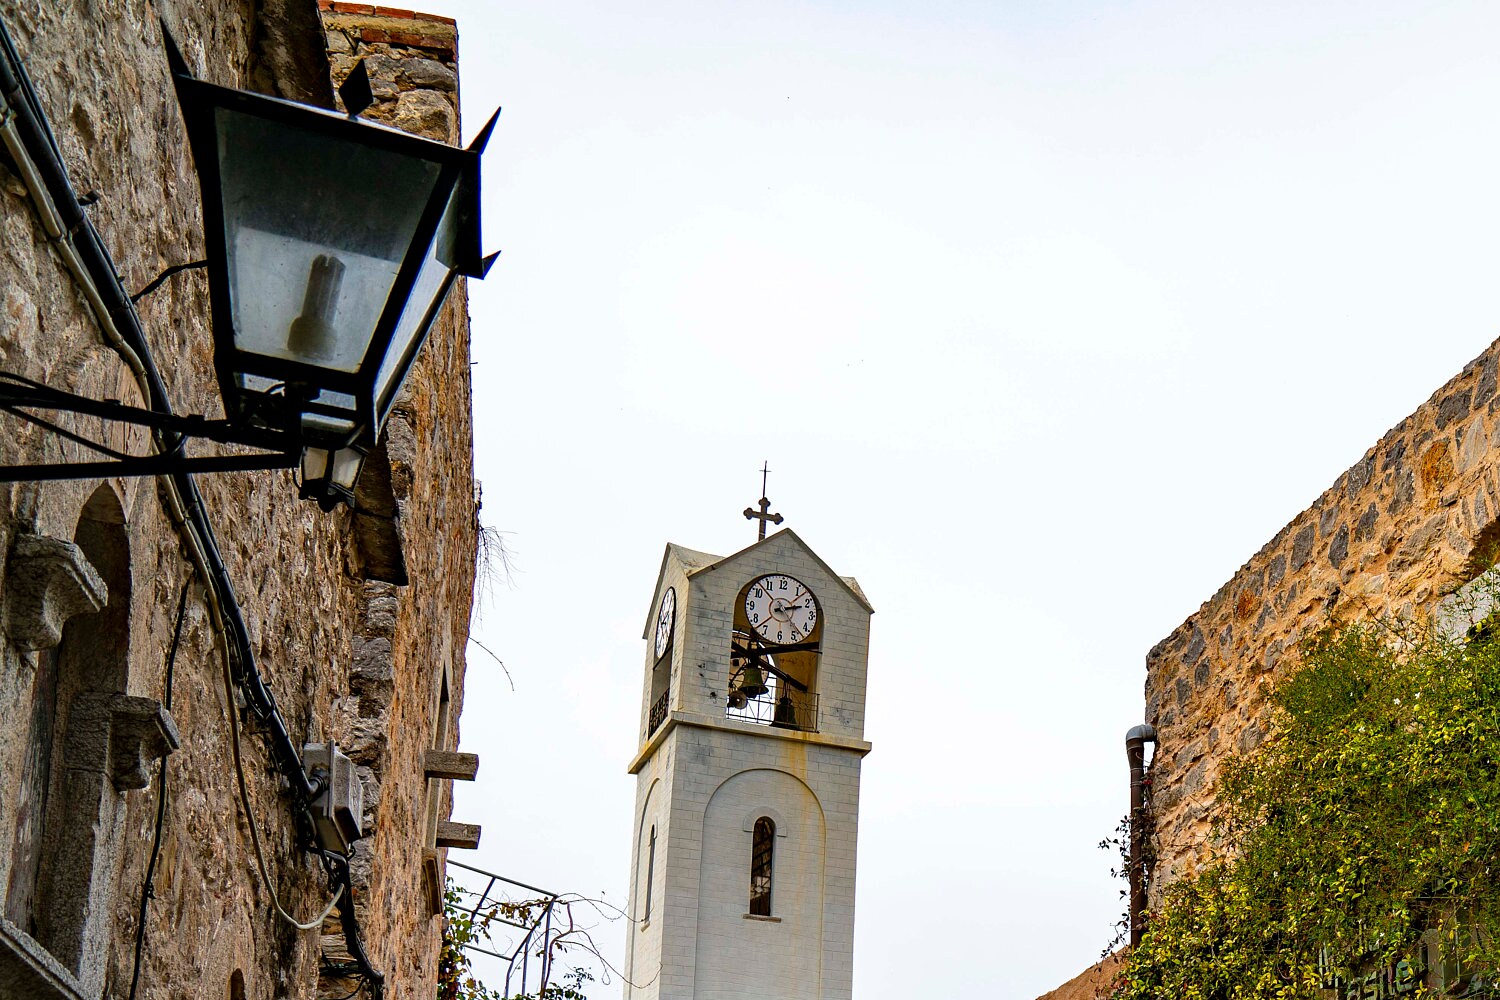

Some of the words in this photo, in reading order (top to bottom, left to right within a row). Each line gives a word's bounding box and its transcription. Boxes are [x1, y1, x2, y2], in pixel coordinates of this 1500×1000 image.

[766, 580, 774, 591] 11
[778, 579, 788, 590] 12
[754, 588, 763, 598] 10
[749, 600, 755, 610] 9
[804, 598, 810, 608] 2
[753, 613, 759, 623] 8
[808, 610, 814, 620] 3
[762, 625, 768, 635] 7
[802, 622, 808, 632] 4
[777, 630, 782, 640] 6
[790, 631, 796, 640] 5
